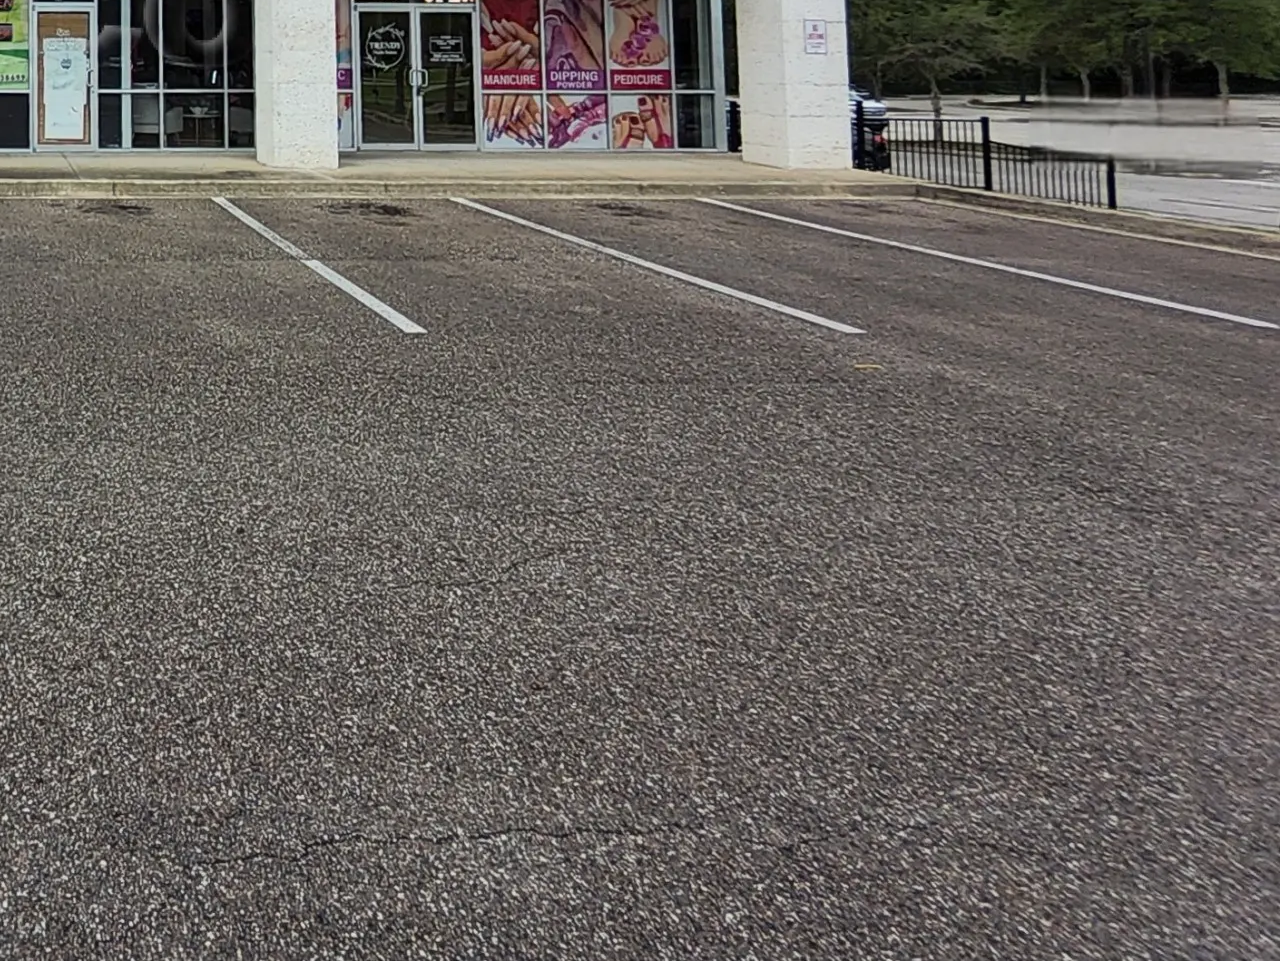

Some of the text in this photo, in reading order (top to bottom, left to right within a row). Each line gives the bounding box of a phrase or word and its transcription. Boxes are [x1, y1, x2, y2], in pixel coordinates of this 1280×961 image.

[369, 41, 400, 49] TRENDY
[484, 74, 536, 85] MANICURE
[550, 71, 599, 82] DIPPING
[614, 74, 664, 85] PEDICURE
